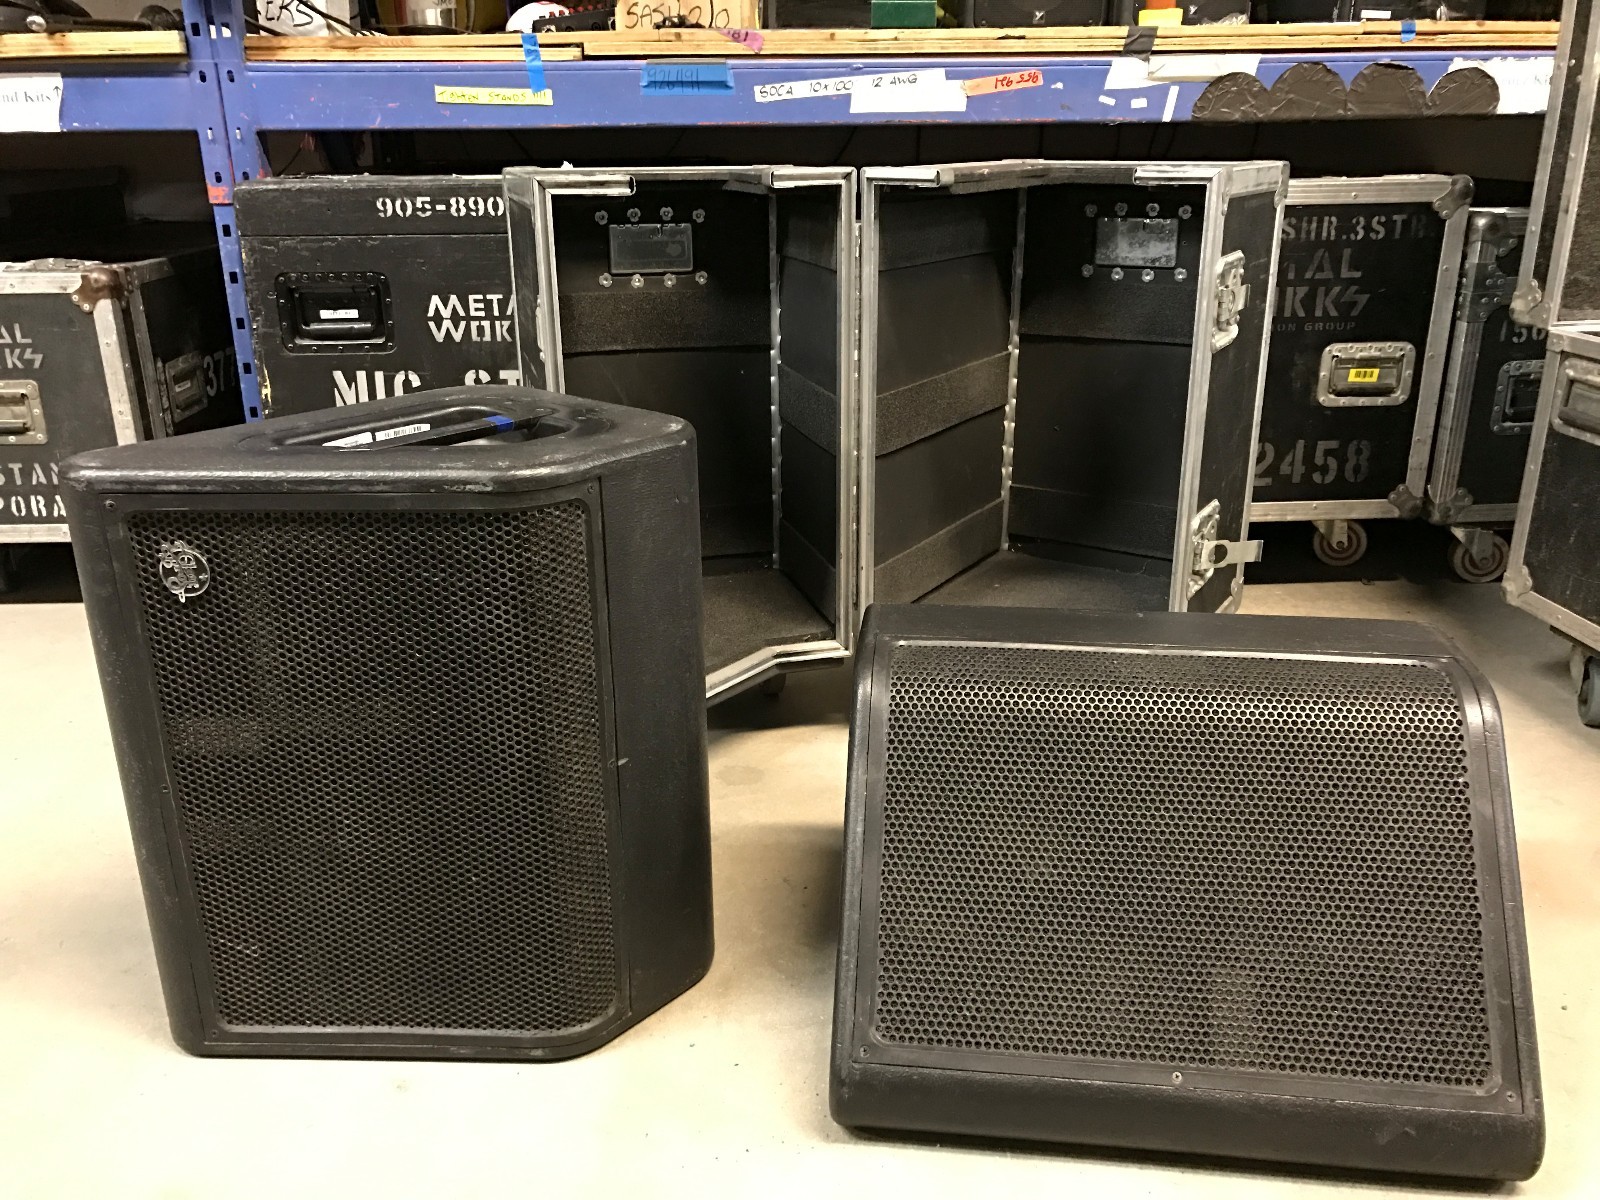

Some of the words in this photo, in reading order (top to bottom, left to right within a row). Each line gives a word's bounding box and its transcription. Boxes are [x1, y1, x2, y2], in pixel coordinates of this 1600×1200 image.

[759, 84, 794, 99] SOCA
[871, 76, 883, 88] 12
[889, 73, 918, 86] AWG
[376, 196, 505, 218] 905-890
[1273, 285, 1371, 318] RKS
[0, 347, 44, 369] KS
[1252, 439, 1372, 487] 2458
